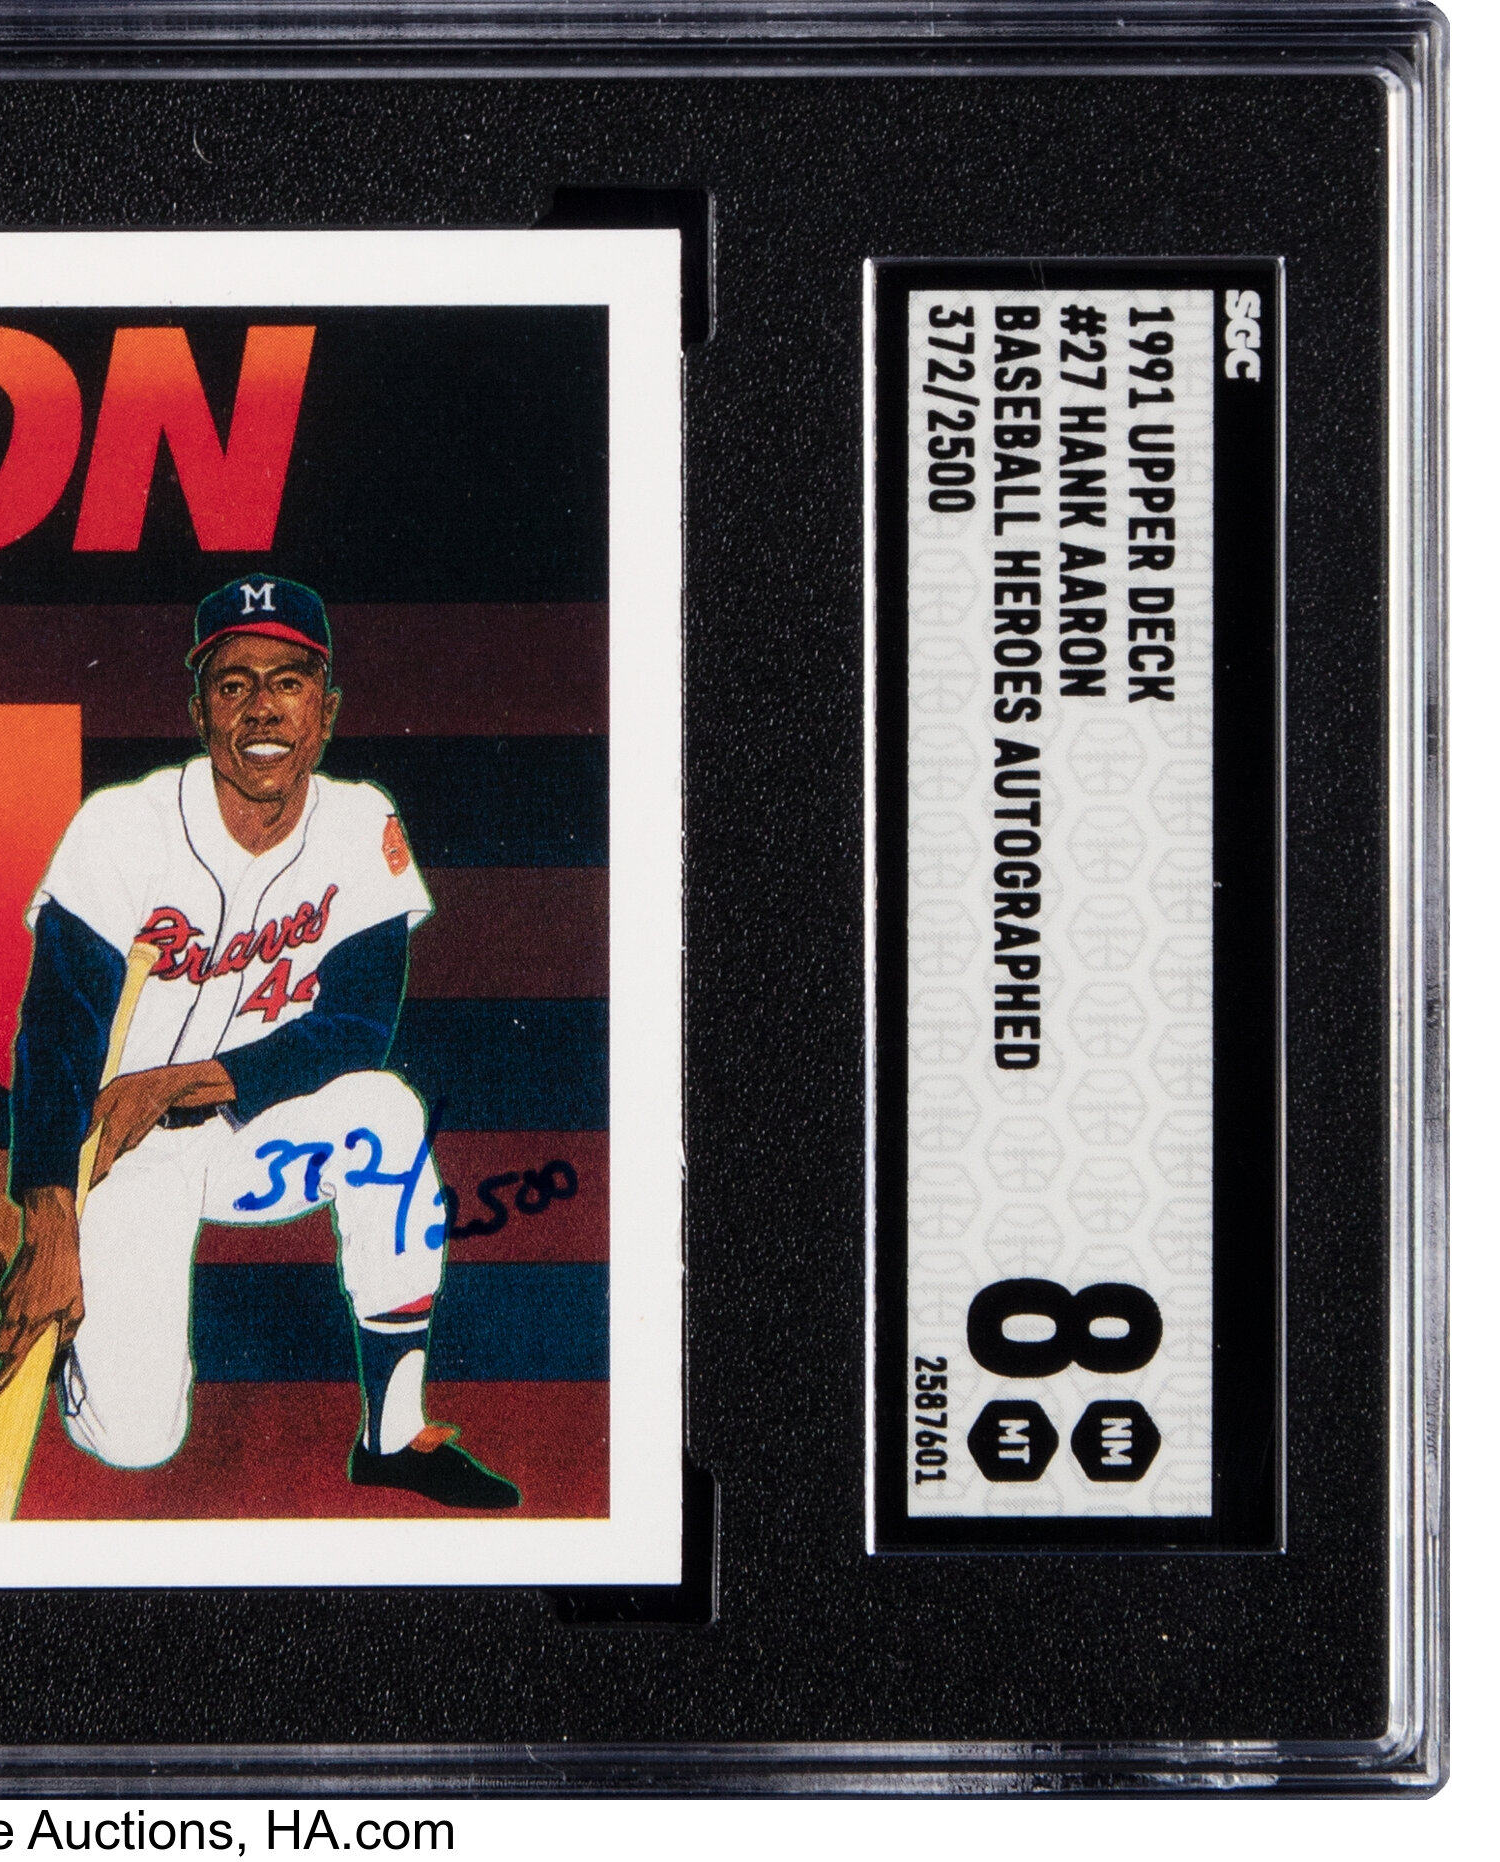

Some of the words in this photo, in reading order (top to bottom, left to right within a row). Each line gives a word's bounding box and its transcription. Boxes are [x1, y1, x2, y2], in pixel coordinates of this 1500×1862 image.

[1059, 304, 1107, 391] #27
[1128, 306, 1175, 409] 1991
[1224, 289, 1262, 382] SGC
[922, 304, 981, 514] 372/2500
[993, 305, 1042, 537] BASEBALL
[1059, 406, 1107, 529] HANK
[1128, 424, 1176, 571] UPPER
[239, 581, 277, 615] M
[993, 550, 1043, 724] HEROES
[1059, 542, 1107, 697] AARON
[1128, 587, 1176, 703] DECK
[134, 883, 339, 985] Braves
[993, 738, 1042, 1071] AUTOGRAPHED
[966, 1277, 1164, 1379] 8
[914, 1356, 949, 1487] 2587601
[998, 1419, 1031, 1465] MT
[1100, 1417, 1133, 1467] NM
